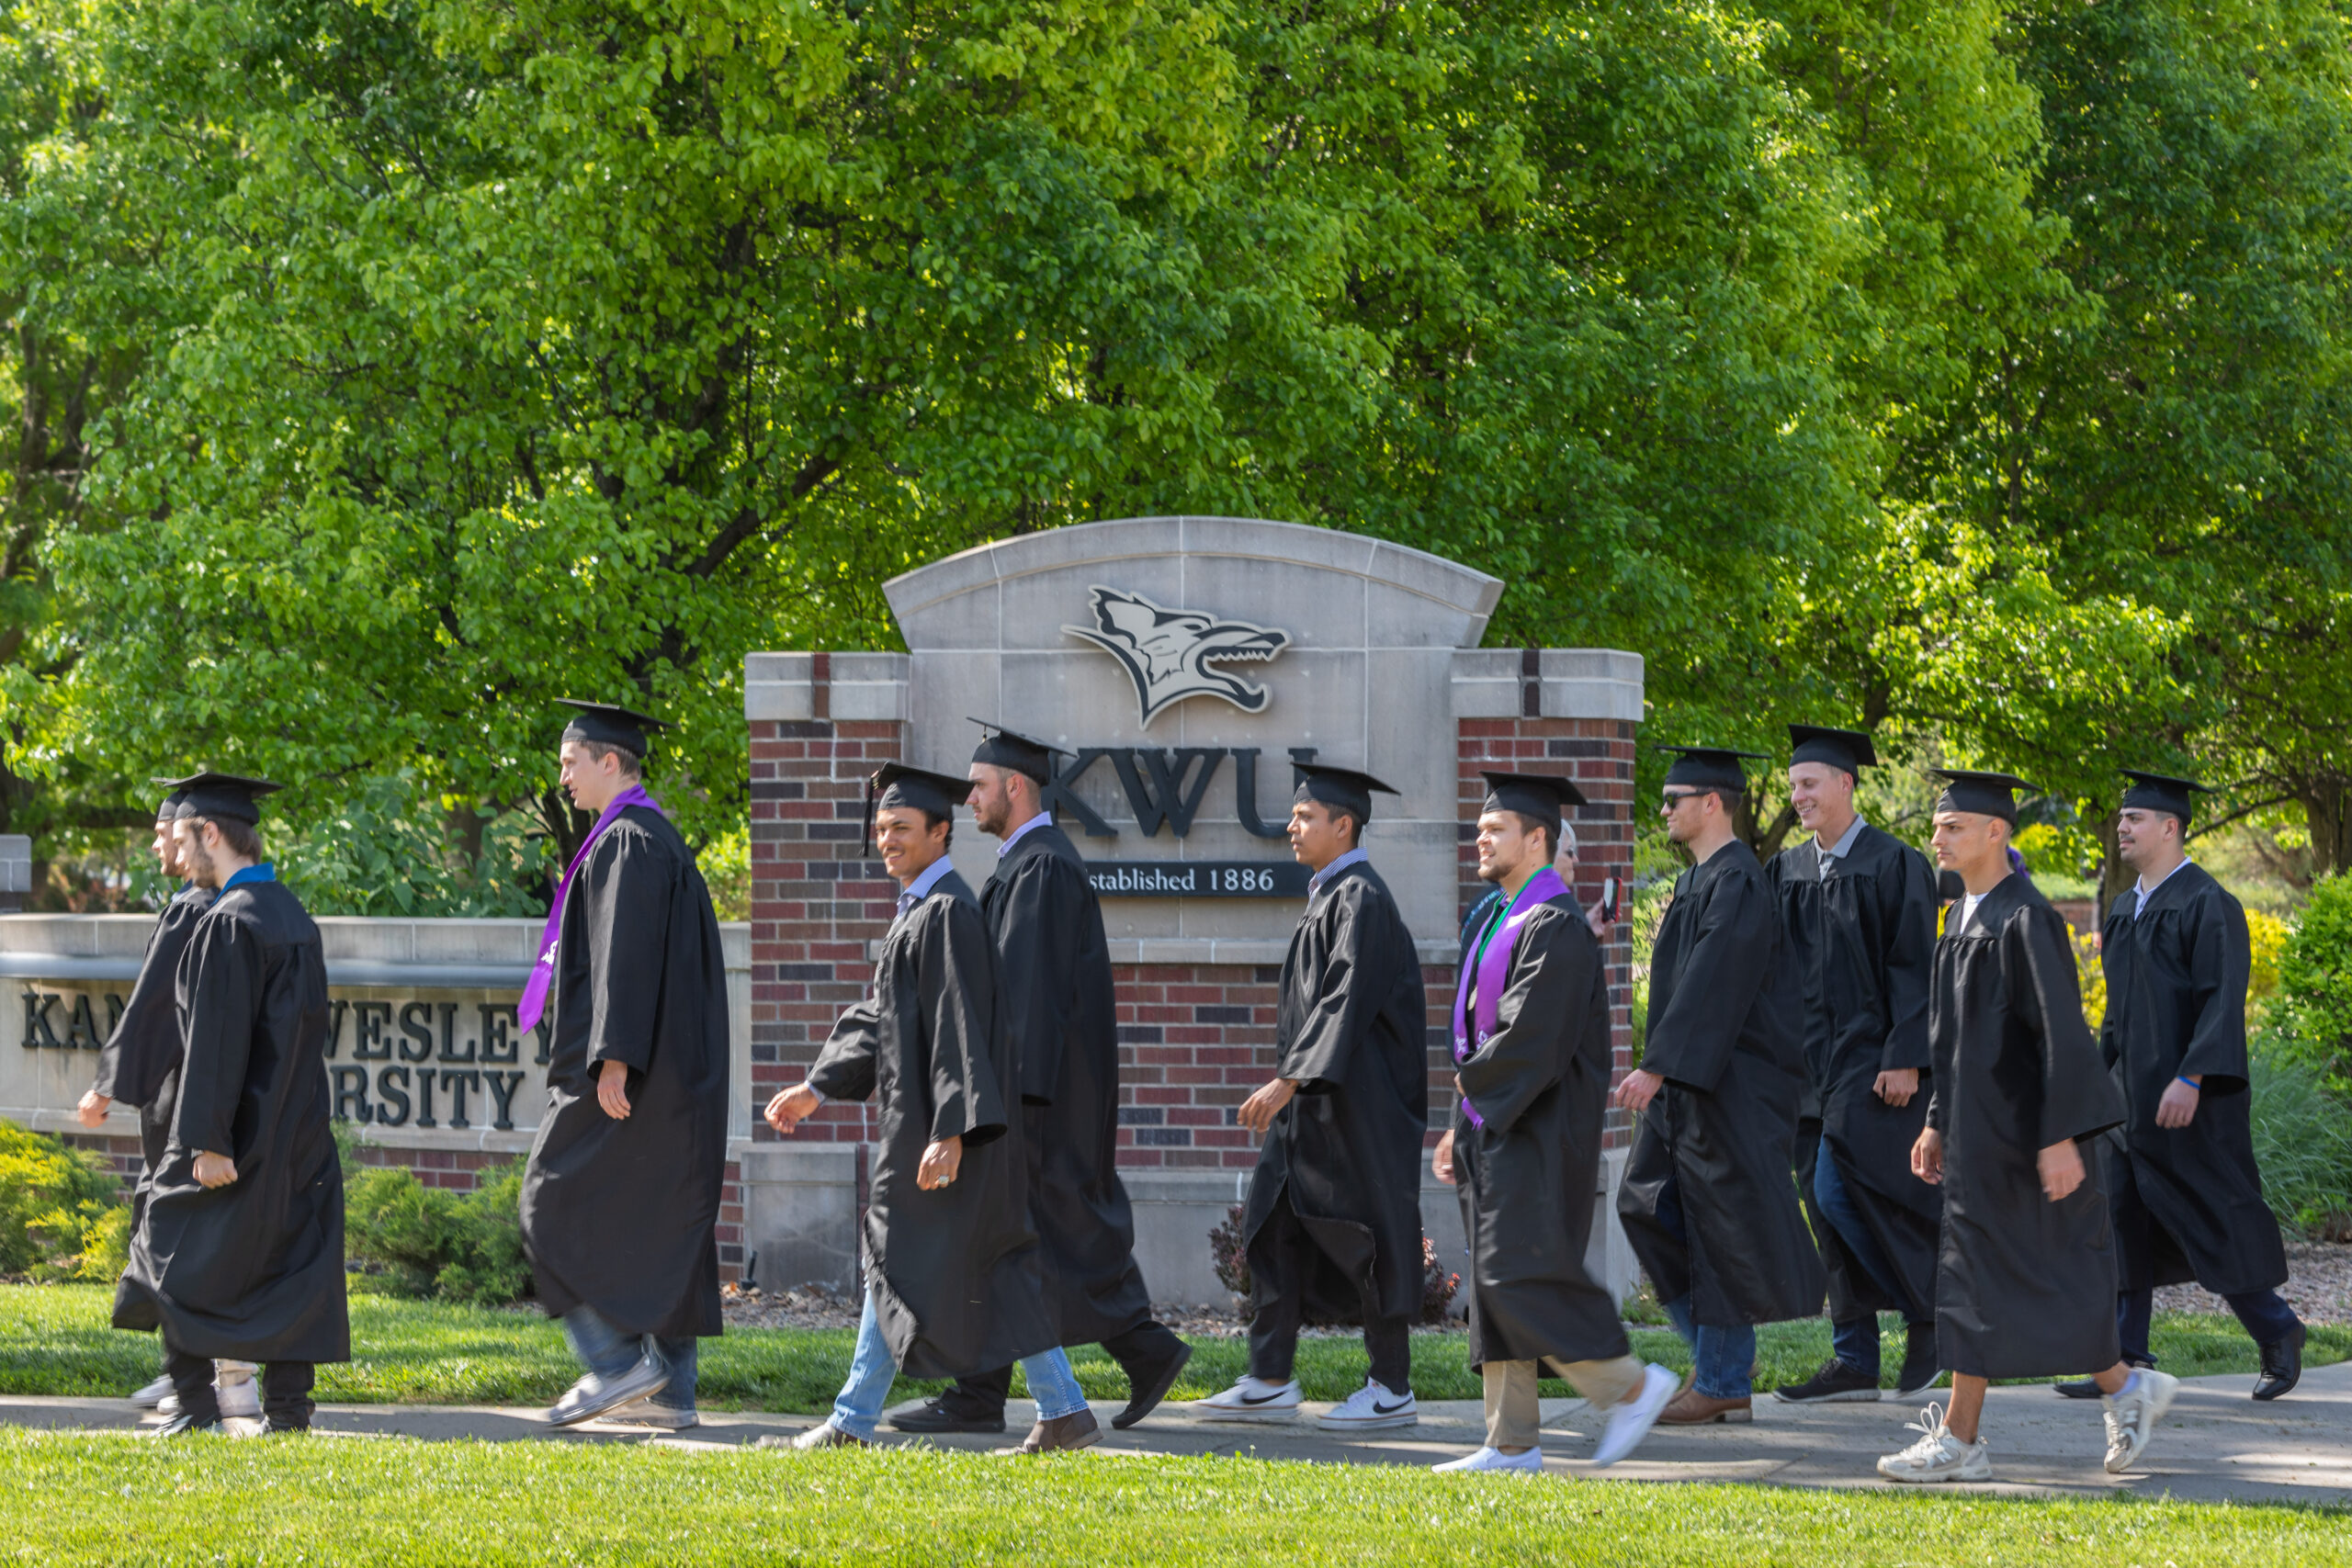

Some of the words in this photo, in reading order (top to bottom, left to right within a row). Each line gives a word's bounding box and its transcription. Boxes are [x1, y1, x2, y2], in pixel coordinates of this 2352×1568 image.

[1040, 748, 1317, 839] KWU
[1089, 867, 1195, 891] stablished
[1210, 868, 1274, 891] 1886
[21, 994, 134, 1049] KAN
[329, 1065, 525, 1130] RSITY
